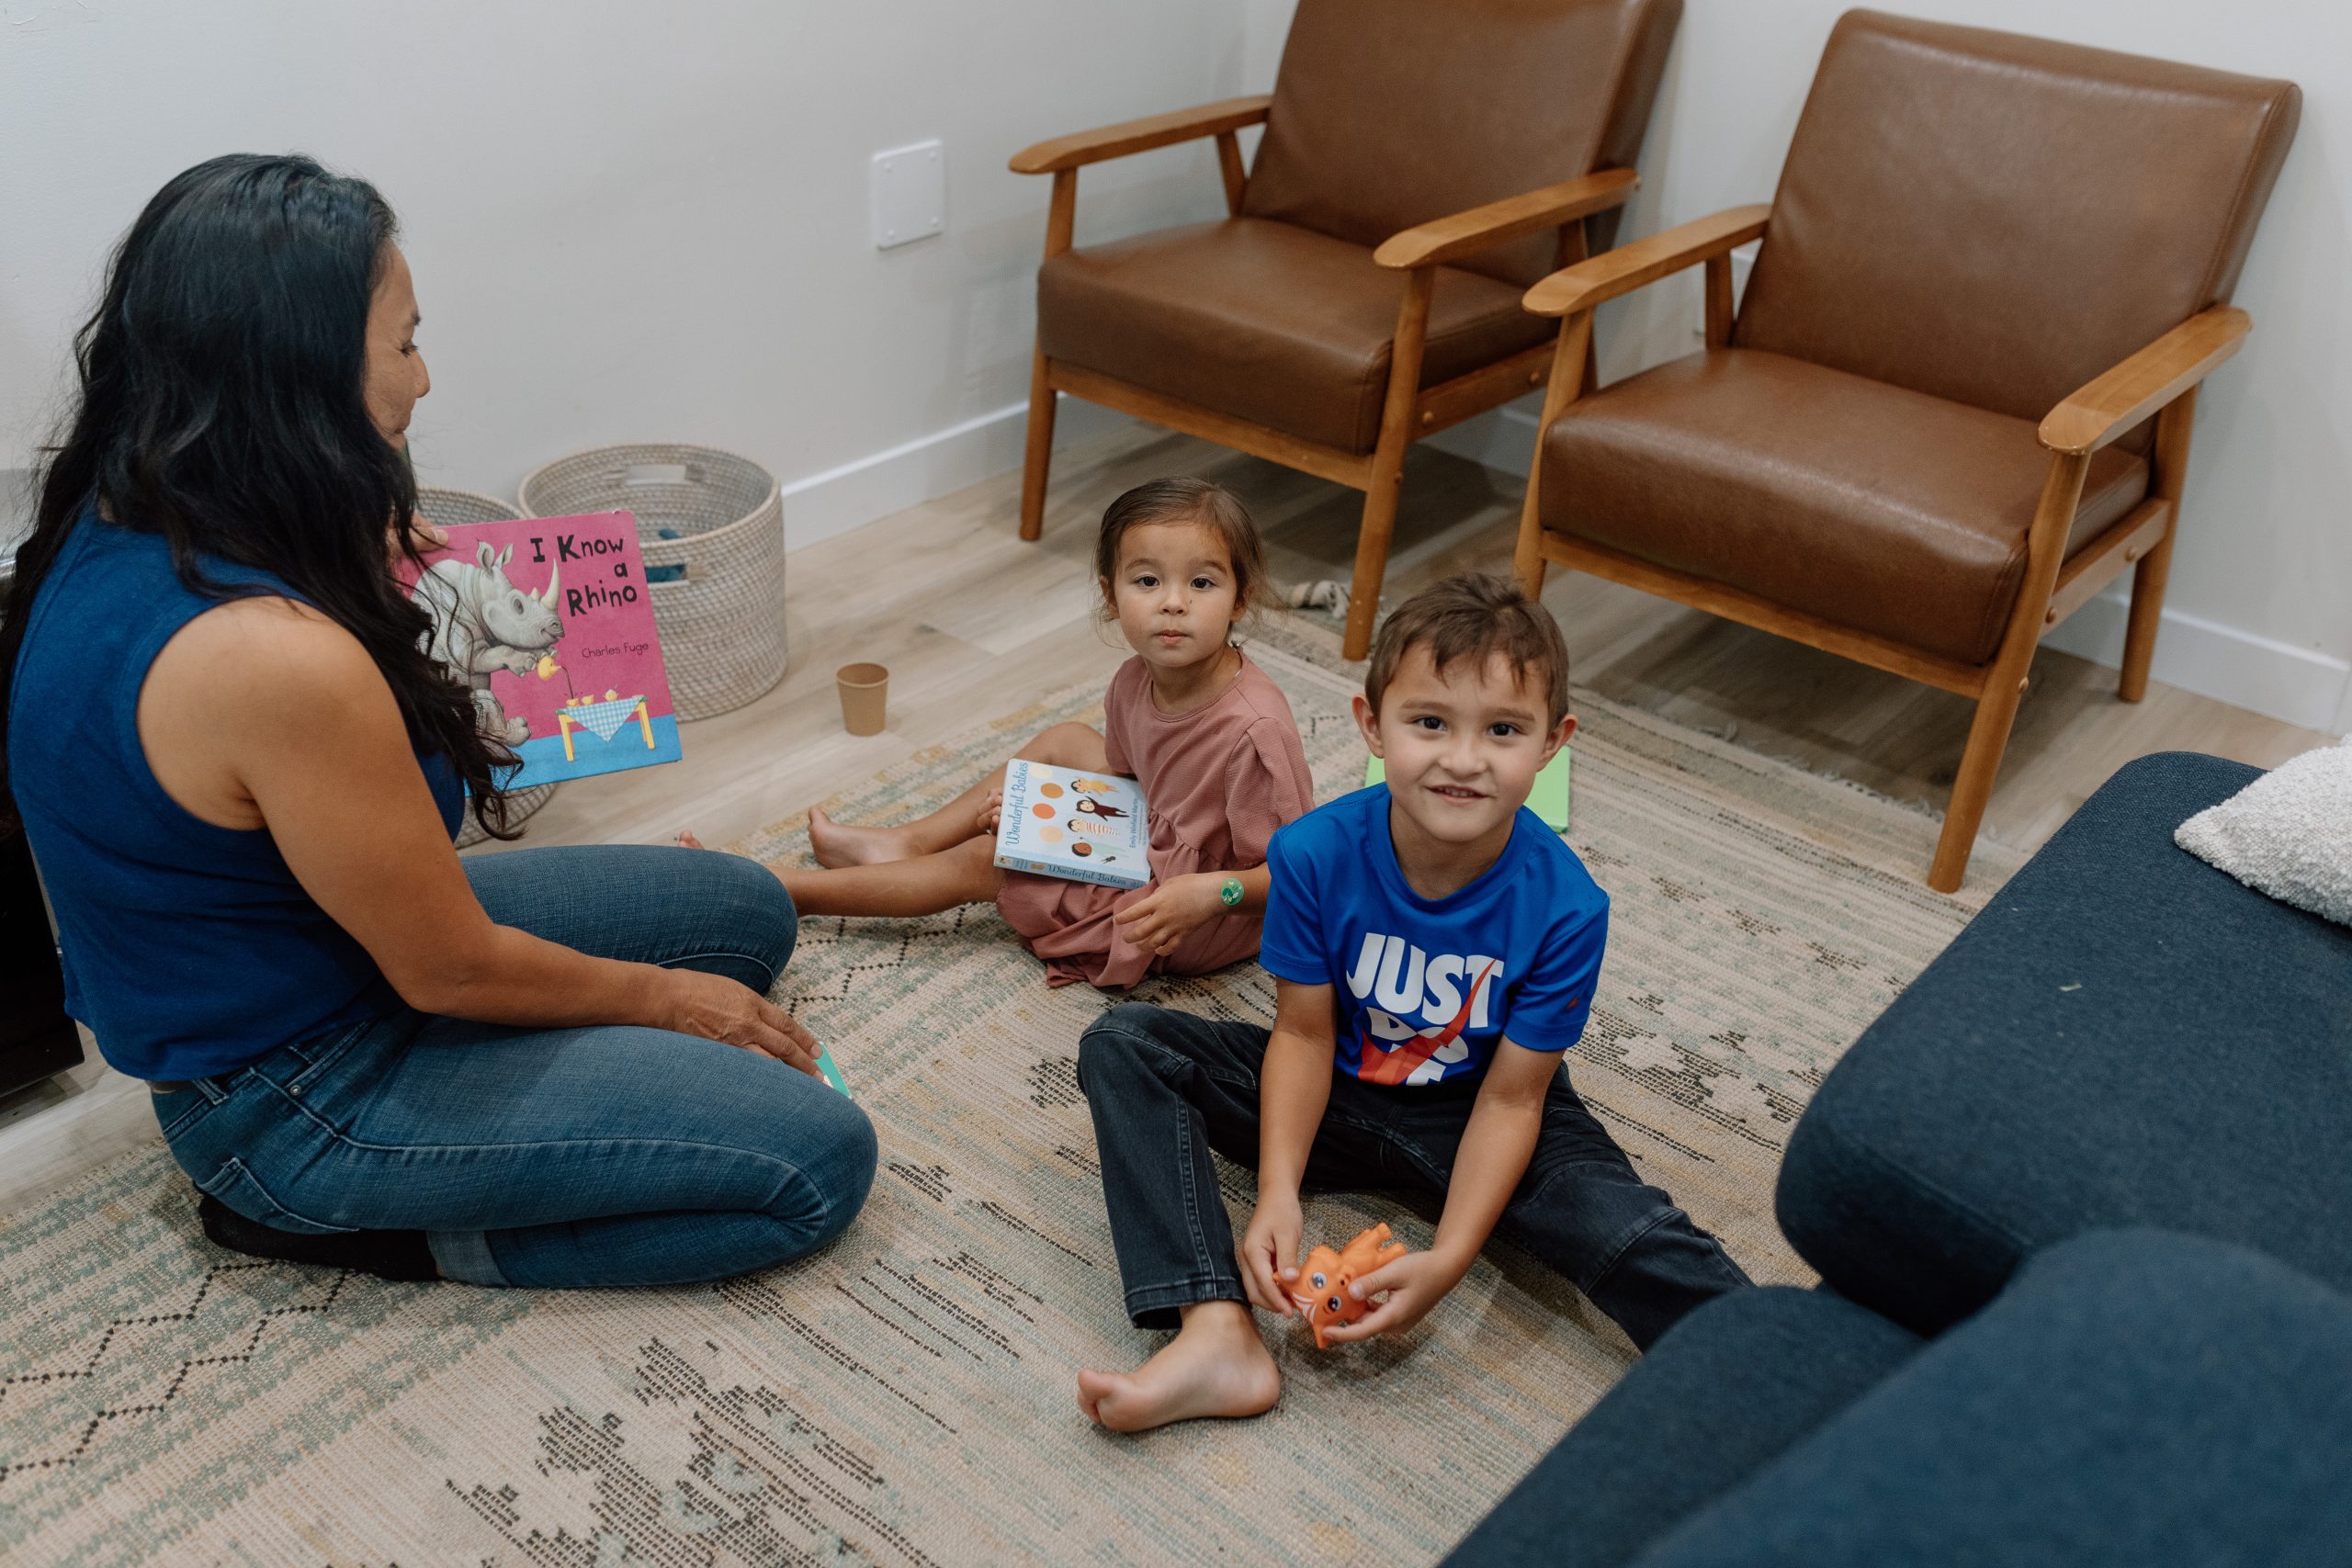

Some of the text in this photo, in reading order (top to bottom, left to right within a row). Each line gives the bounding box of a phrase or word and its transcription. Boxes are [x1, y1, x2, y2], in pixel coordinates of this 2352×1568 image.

[530, 535, 624, 562] I Know
[614, 562, 628, 578] a
[566, 580, 638, 617] Rhino
[582, 642, 650, 659] Charles Fuge
[1012, 762, 1028, 794] Babies
[1005, 795, 1029, 846] Wonderful
[1047, 864, 1094, 881] Wonderful
[1097, 872, 1126, 886] Babies
[1346, 932, 1505, 1028] JUST
